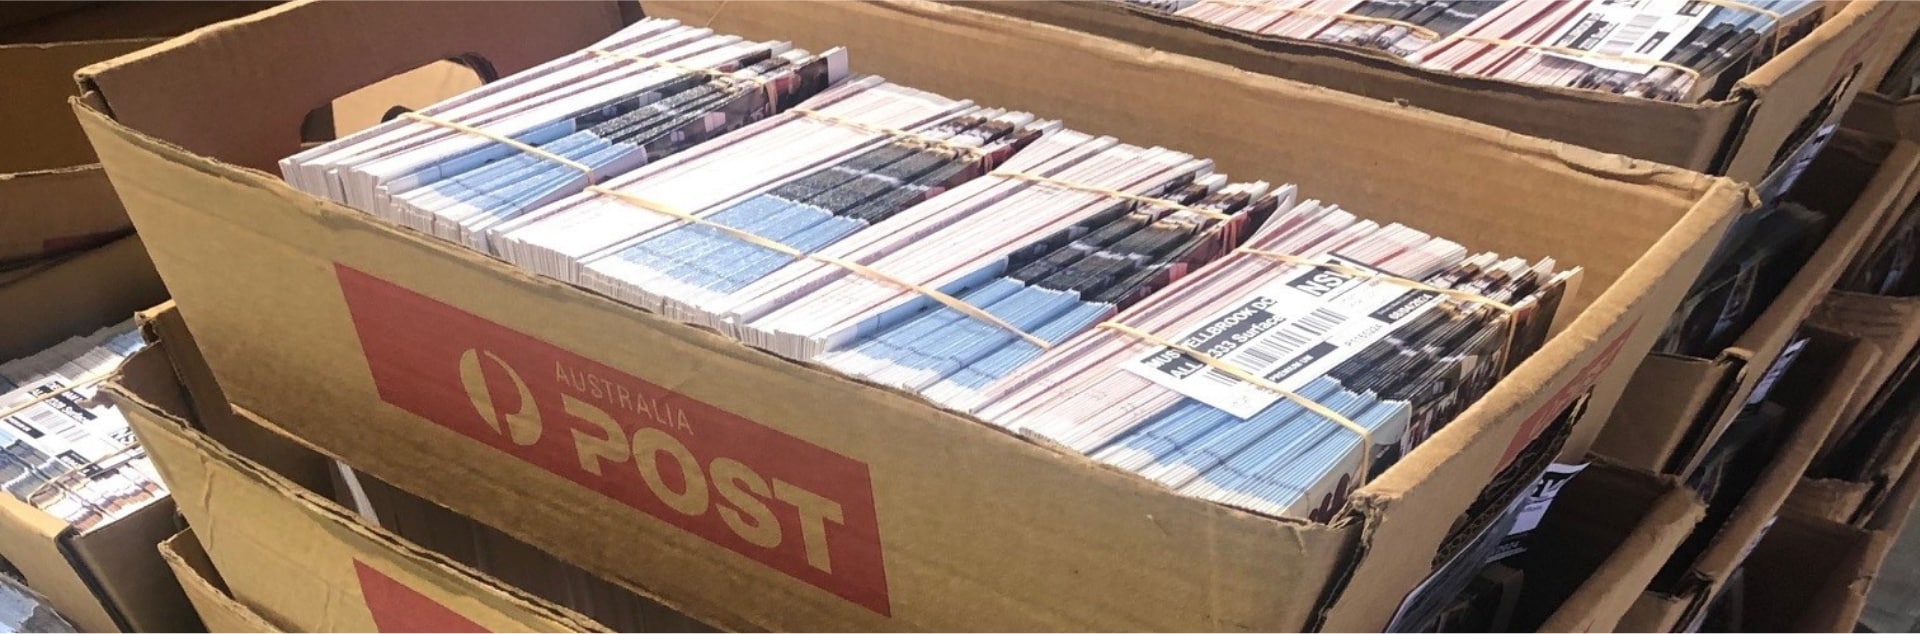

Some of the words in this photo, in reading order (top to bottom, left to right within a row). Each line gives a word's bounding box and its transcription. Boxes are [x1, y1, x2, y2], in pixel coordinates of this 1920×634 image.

[1142, 307, 1259, 368] MUSELLBROOK
[1169, 362, 1204, 380] ALL
[1204, 340, 1237, 361] 333
[1231, 314, 1285, 343] Surface
[555, 361, 695, 435] AUSTRALIA
[561, 393, 844, 575] POST
